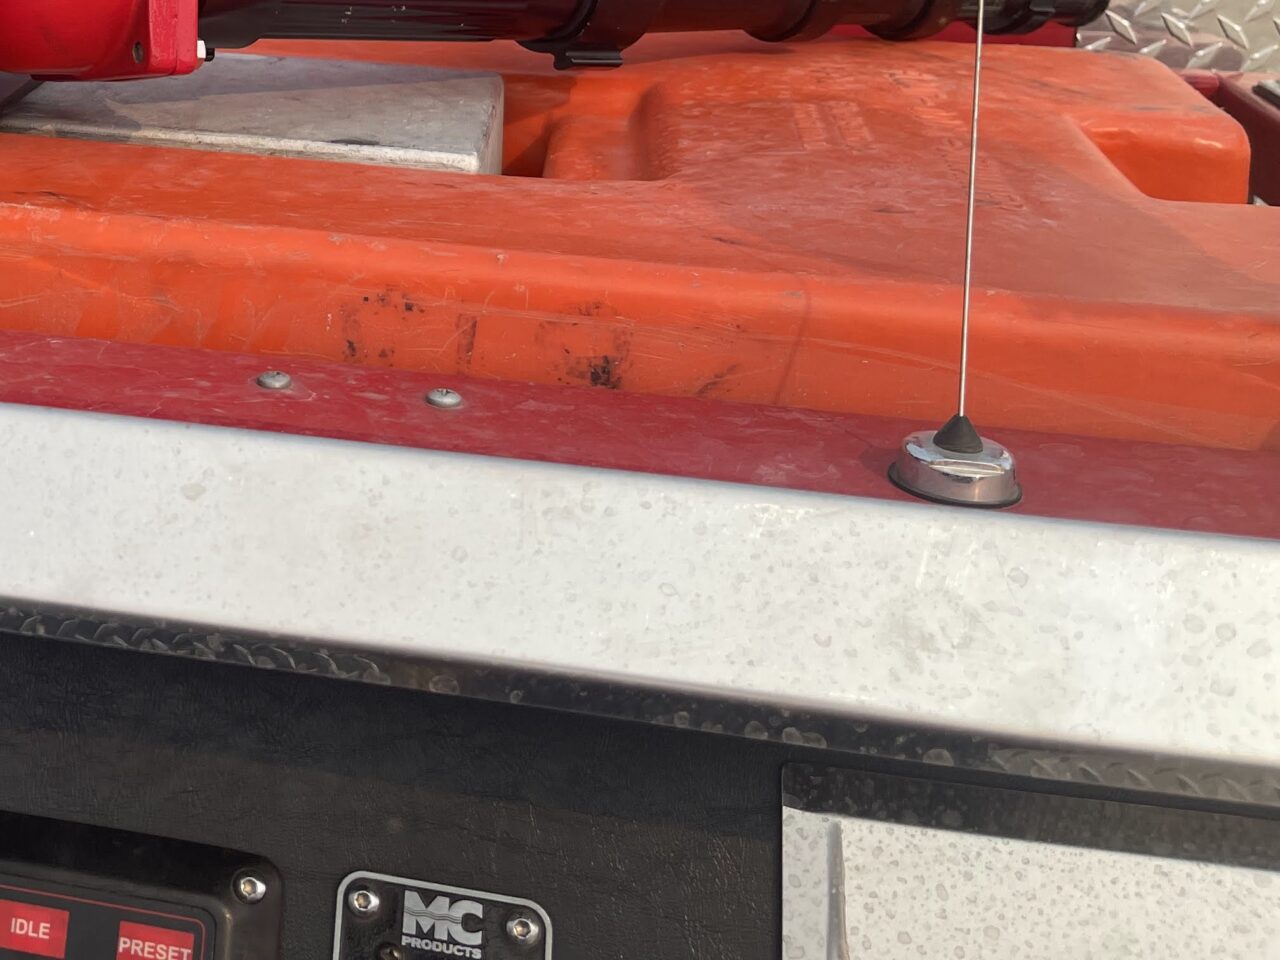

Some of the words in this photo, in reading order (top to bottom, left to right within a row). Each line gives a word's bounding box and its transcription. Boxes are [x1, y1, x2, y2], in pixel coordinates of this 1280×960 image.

[10, 917, 51, 939] IDLE
[402, 890, 484, 946] MC
[118, 937, 191, 960] PRESET
[401, 934, 482, 959] PRODUCTS
